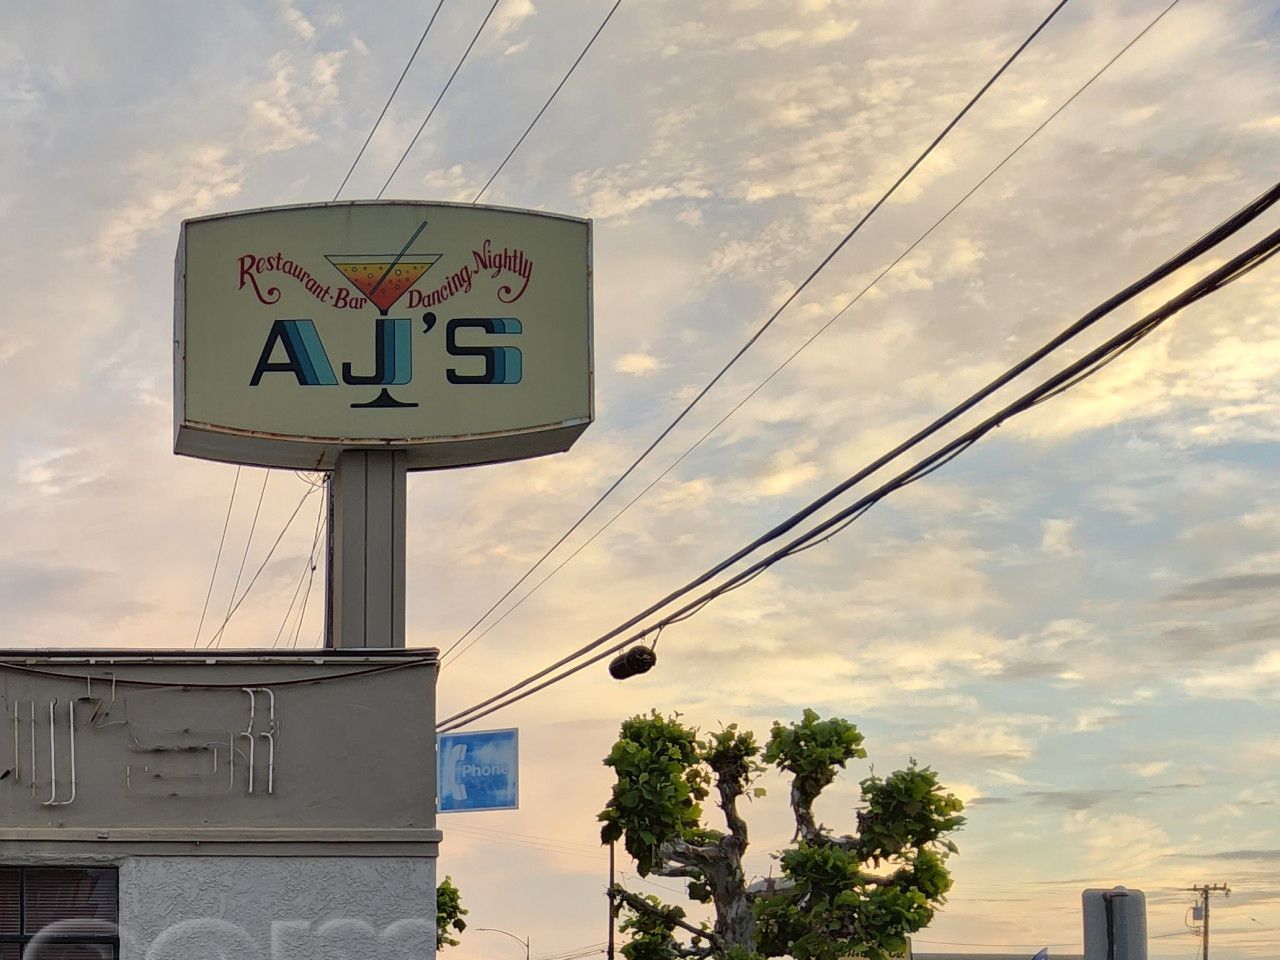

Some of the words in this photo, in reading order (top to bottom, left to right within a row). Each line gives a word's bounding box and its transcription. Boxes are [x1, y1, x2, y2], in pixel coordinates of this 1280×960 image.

[238, 252, 330, 305] Restaurant
[407, 264, 474, 309] Dancing
[472, 239, 533, 304] Nightly
[249, 312, 523, 387] AJ'S
[462, 764, 510, 777] Phone
